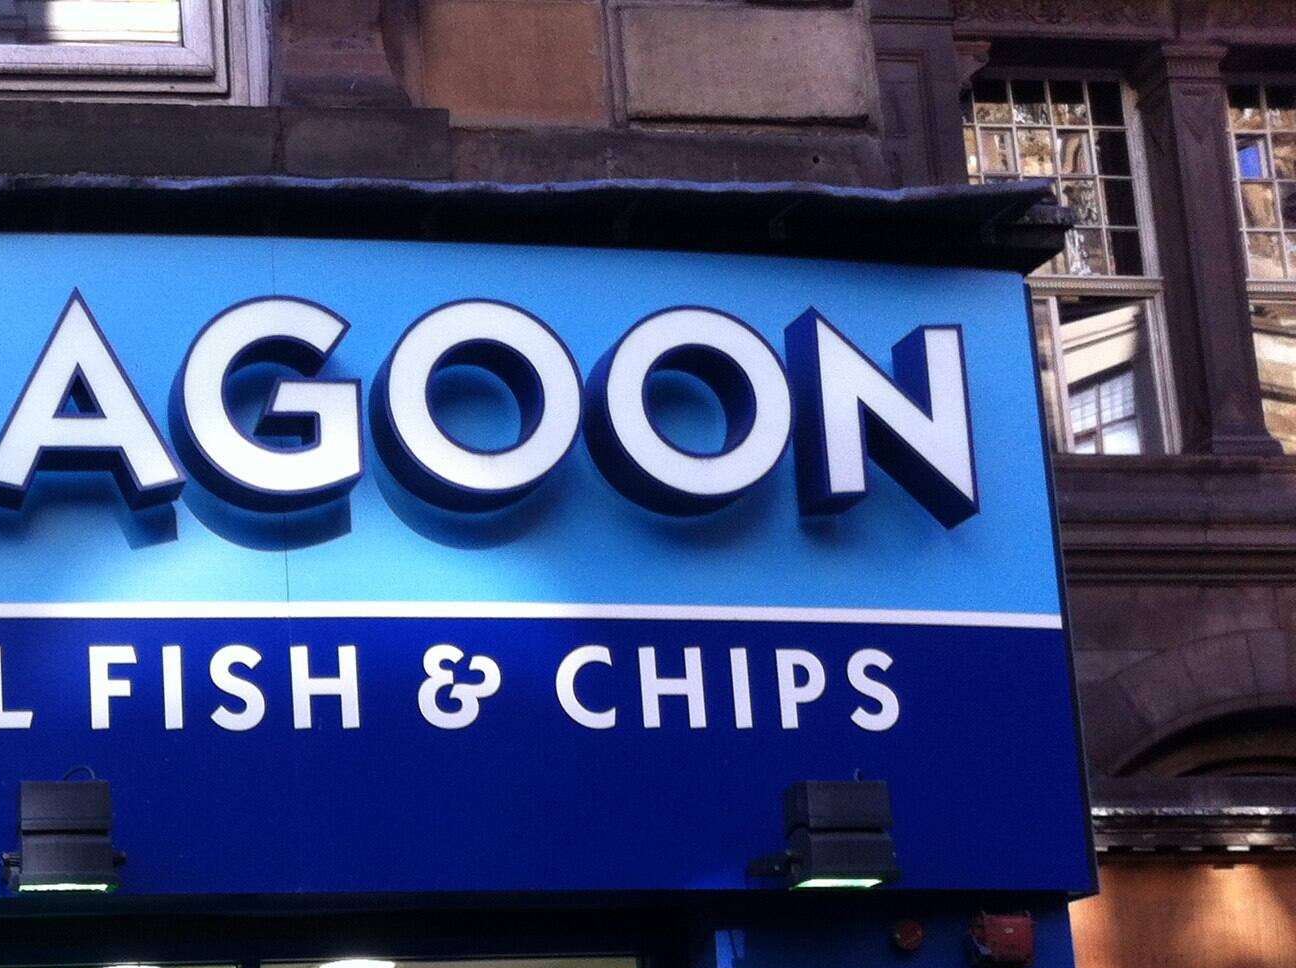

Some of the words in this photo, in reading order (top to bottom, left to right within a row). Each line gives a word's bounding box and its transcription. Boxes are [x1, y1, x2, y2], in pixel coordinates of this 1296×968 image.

[88, 643, 362, 732] FISH
[417, 643, 502, 730] &
[554, 643, 901, 732] CHIPS
